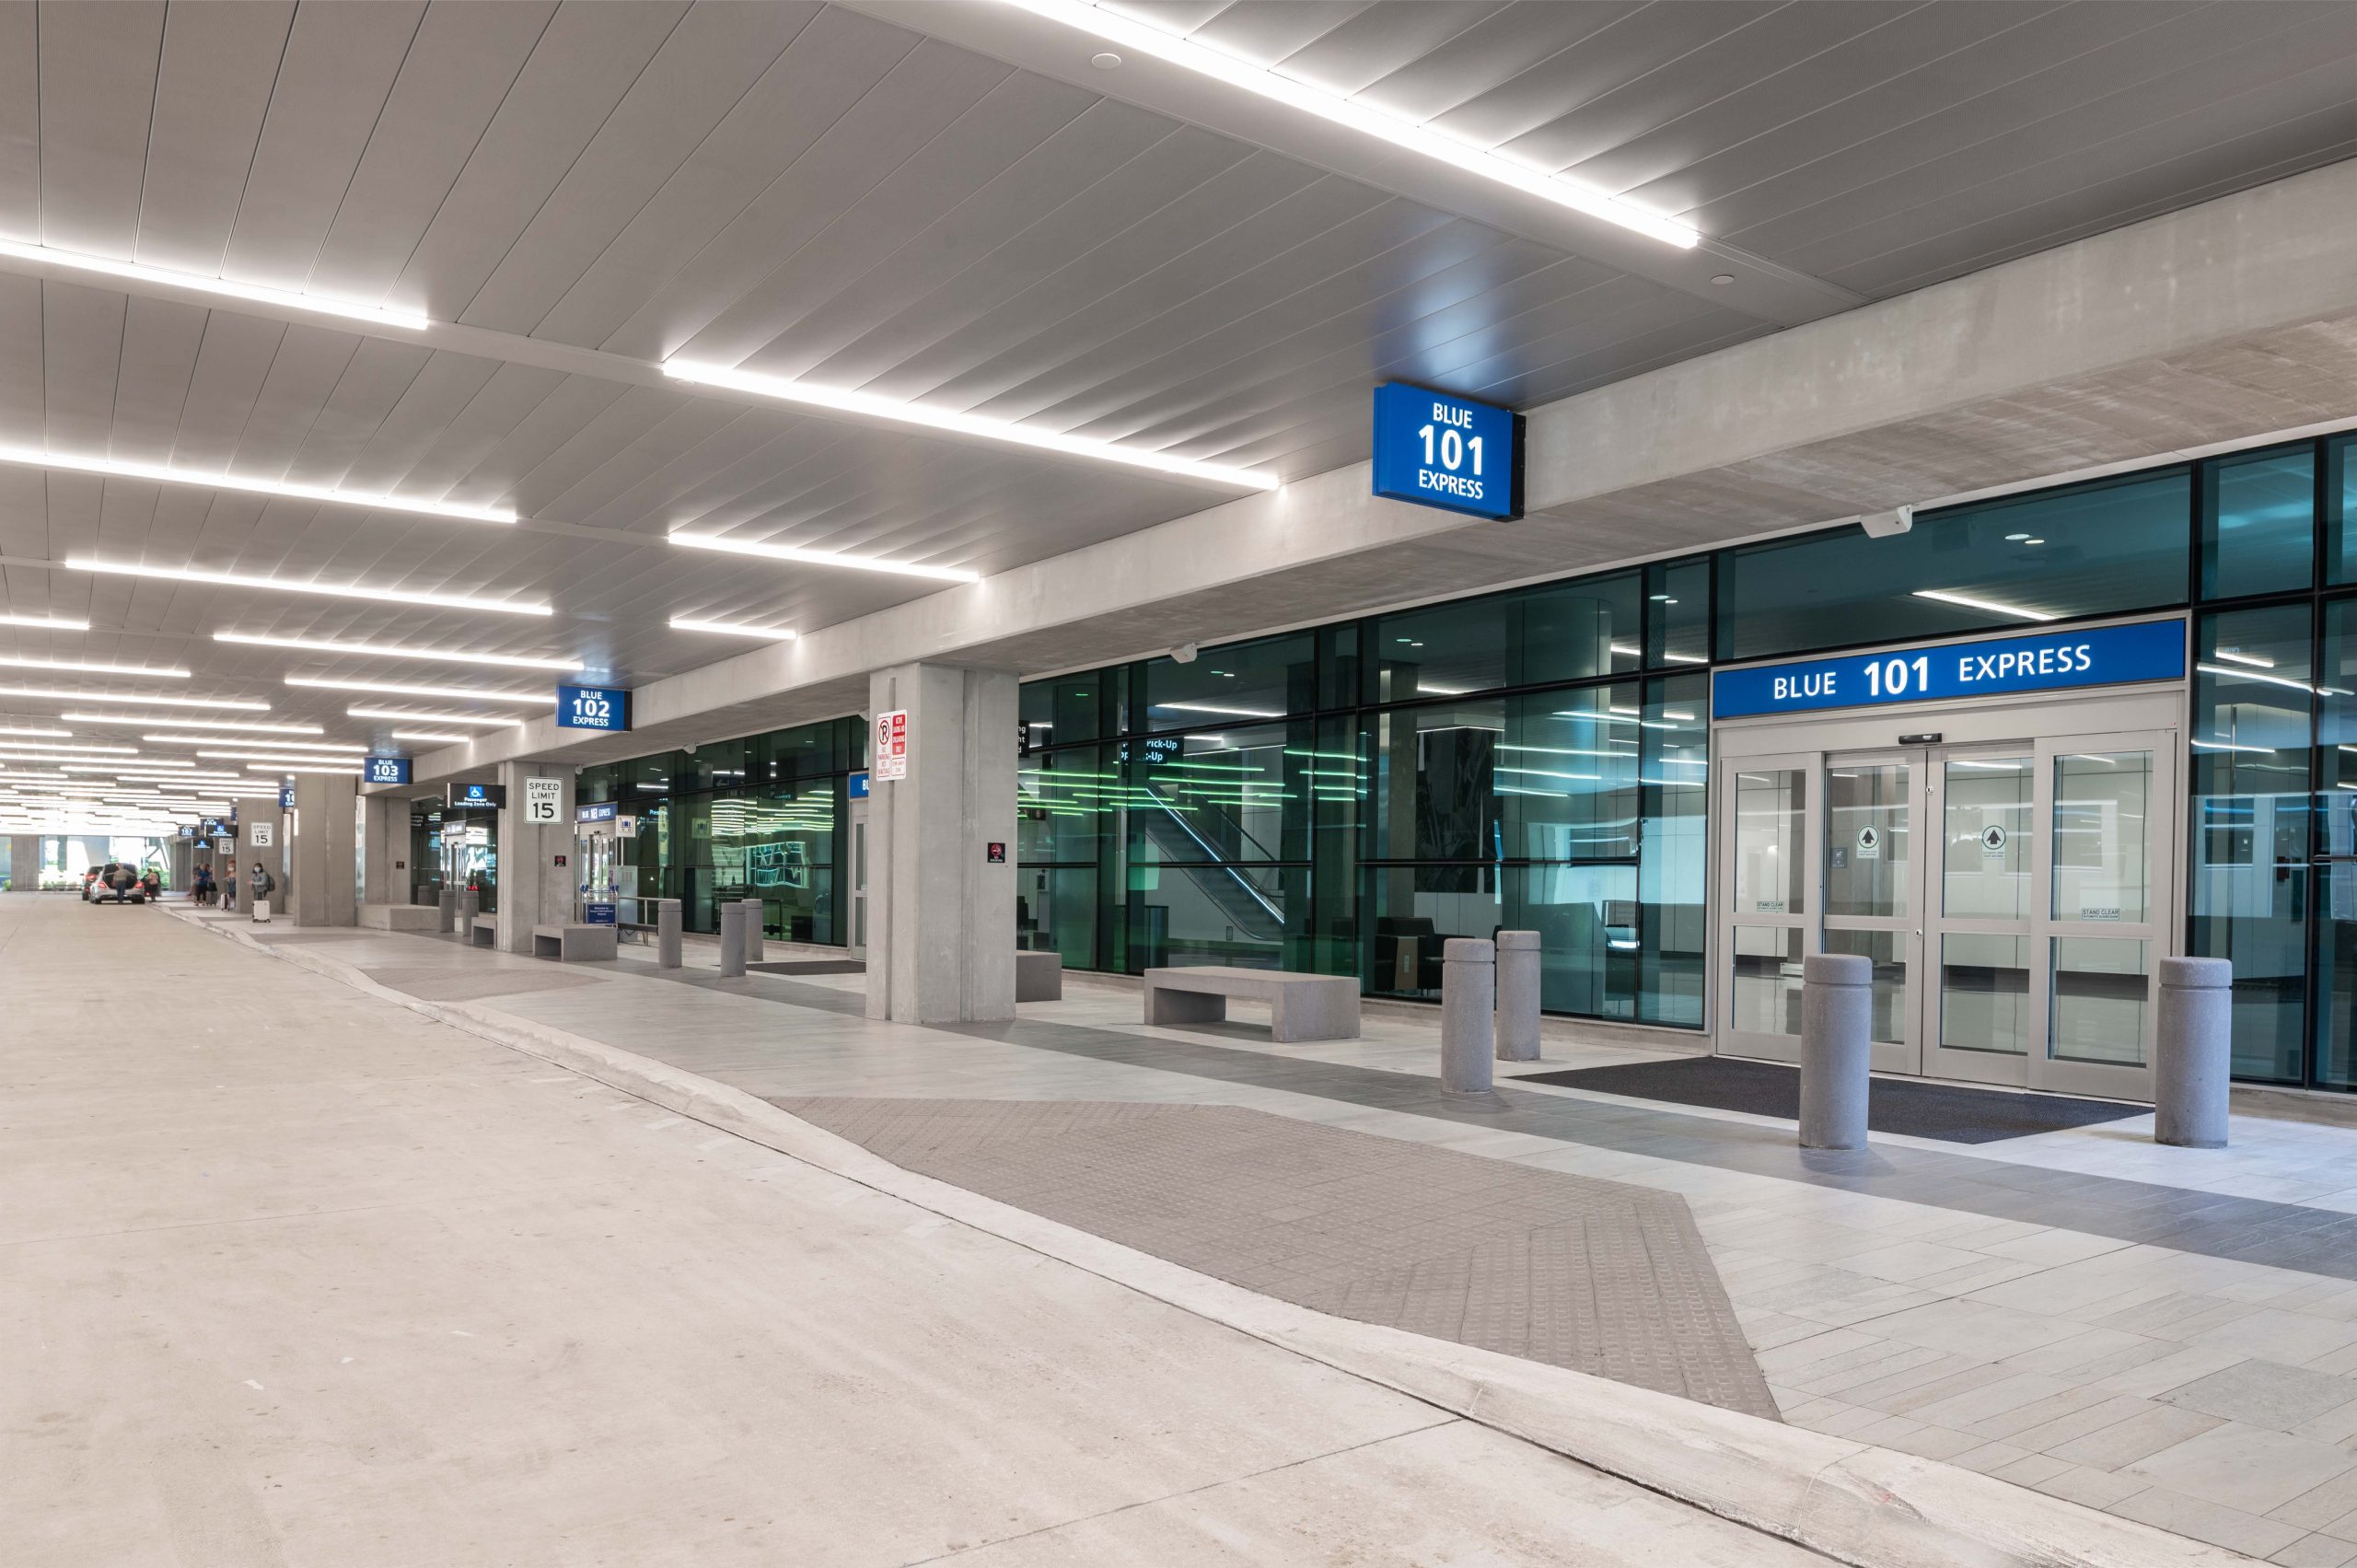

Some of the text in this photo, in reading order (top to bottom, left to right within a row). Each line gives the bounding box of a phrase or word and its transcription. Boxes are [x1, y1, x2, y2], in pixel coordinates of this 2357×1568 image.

[1433, 402, 1473, 429] BLUE
[1418, 424, 1482, 475] 101
[1419, 469, 1483, 500] EXPRESS
[1773, 645, 2091, 700] BLUE 101 EXPRESS
[580, 690, 603, 700] BLUE
[573, 699, 610, 717] 102
[573, 716, 609, 726] EXPRESS
[373, 765, 399, 776] 103
[528, 783, 560, 791] SPEED
[531, 792, 556, 800] LIMIT
[533, 802, 554, 819] 15
[255, 834, 268, 843] 15
